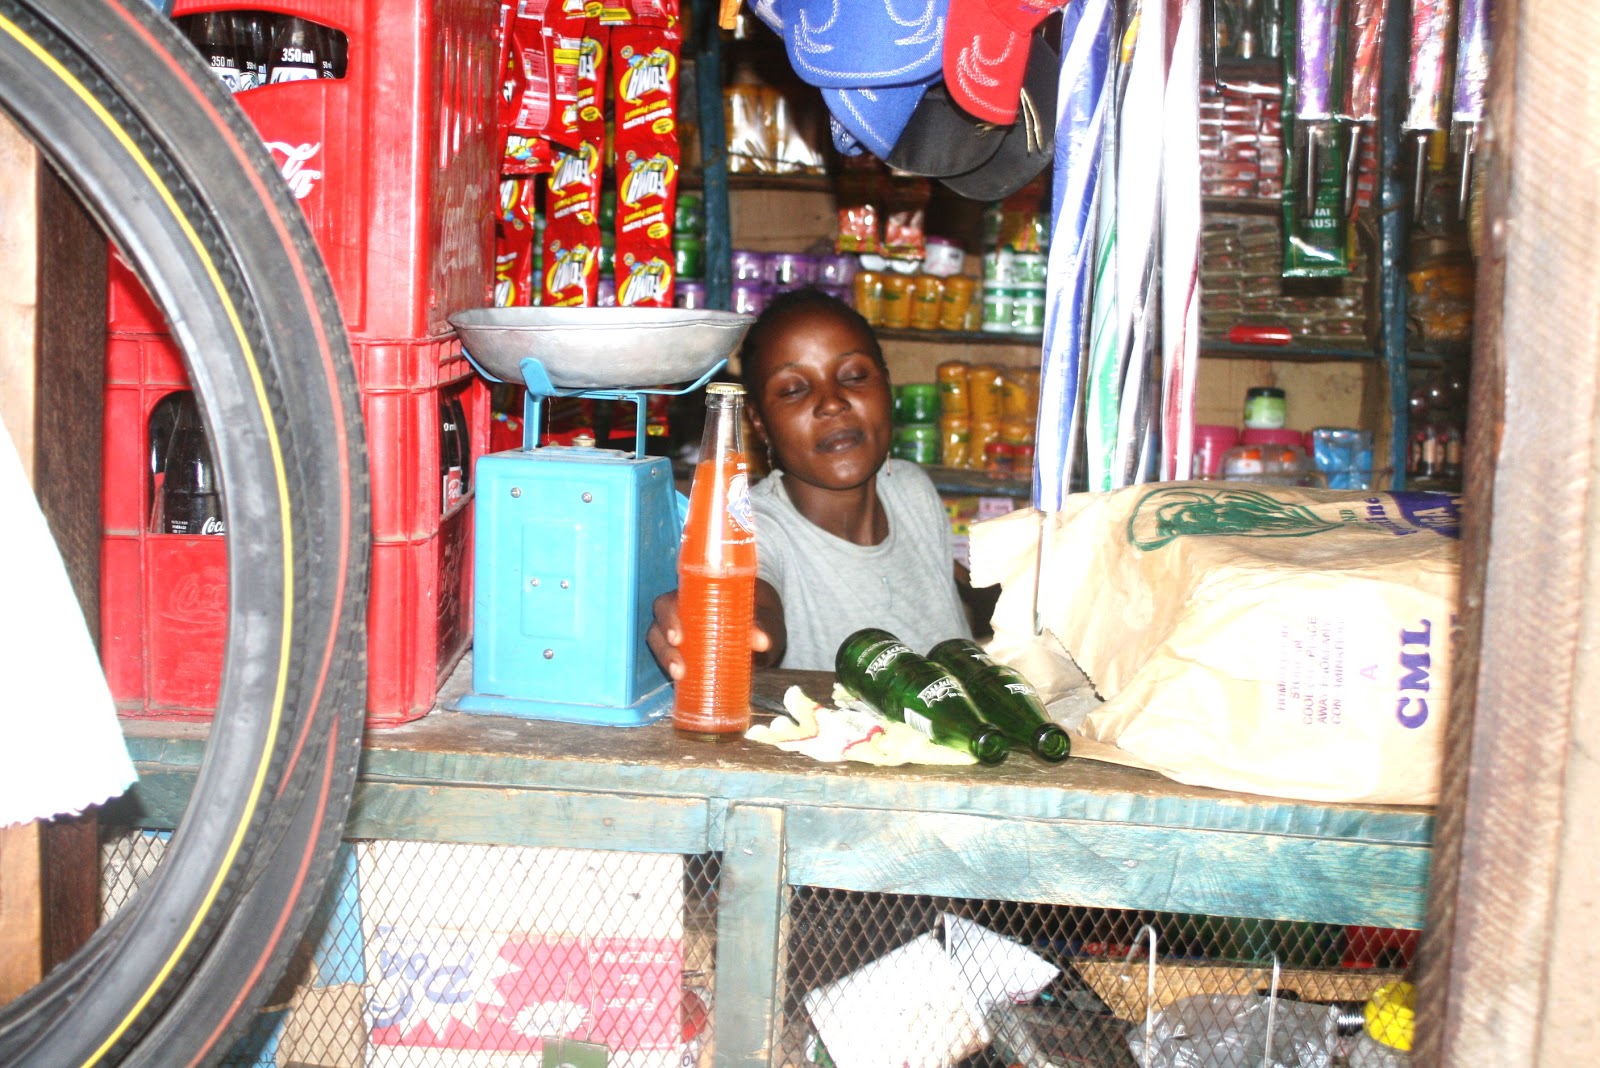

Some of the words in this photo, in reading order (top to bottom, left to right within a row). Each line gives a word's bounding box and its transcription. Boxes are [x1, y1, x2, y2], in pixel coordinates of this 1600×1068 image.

[211, 56, 225, 67] 350
[226, 58, 235, 68] ml
[281, 48, 301, 62] 350
[302, 50, 314, 64] ml
[1396, 618, 1432, 729] CML
[1303, 694, 1314, 725] COOL
[588, 951, 676, 964] TANZANA
